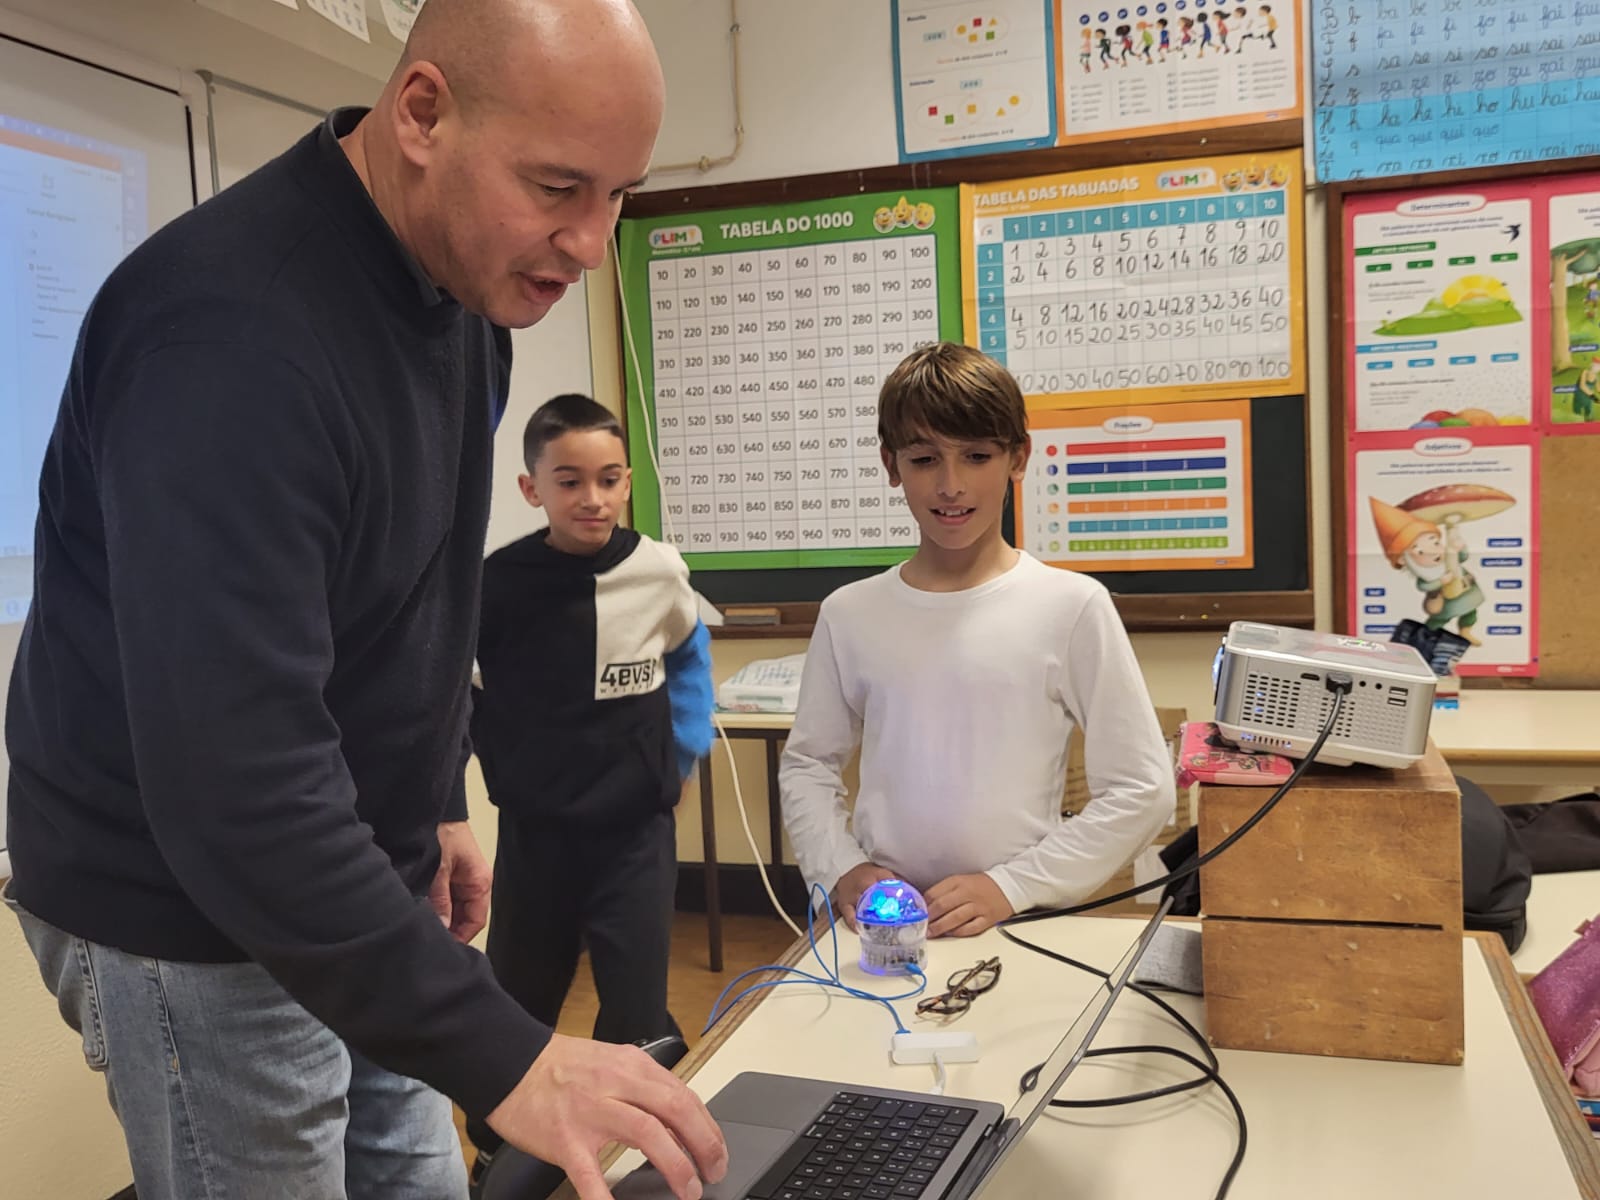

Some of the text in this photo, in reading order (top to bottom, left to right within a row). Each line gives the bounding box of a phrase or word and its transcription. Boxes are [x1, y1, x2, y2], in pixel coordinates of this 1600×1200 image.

[974, 177, 1139, 207] TABELA DAS TABUADAS
[719, 211, 854, 240] TABELA DO 1000
[1013, 198, 1277, 234] 1 2 3 4 5 6 7 8 9 10
[987, 249, 993, 260] 1
[1010, 219, 1279, 261] 1 2 3 4 5 6 7 8 9 10
[657, 246, 930, 280] 10 20 30 40 50 60 70 80 90 100
[987, 270, 994, 281] 2
[1010, 241, 1285, 284] 2 4 6 8 10 12 14 16 18 20
[656, 278, 932, 310] 110 120 130 140 150 160 170 180 190 200
[987, 292, 995, 303] 3
[1011, 286, 1283, 327] 4 8 12 16 20 24 28 32 36 40
[658, 309, 933, 340] 210 220 230 240 250 260 270 280 290 300
[988, 314, 996, 324] 4
[1014, 312, 1288, 349] 5 10 15 20 25 30 35 40 45 50
[989, 336, 997, 346] 5
[1038, 374, 1059, 395] 20
[1064, 372, 1087, 391] 30
[1092, 369, 1114, 389] 40
[1118, 368, 1141, 388] 50
[1146, 365, 1170, 384] 60
[1175, 363, 1198, 381] 70
[1204, 360, 1227, 382] 80
[1229, 360, 1252, 378] 90
[1259, 357, 1289, 377] 100
[661, 406, 876, 428] 510 520 530 540 550 560 570 580
[662, 436, 878, 457] 610 620 630 640 650 660 670 680
[692, 526, 910, 543] 920 930 940 950 960 970 980 990
